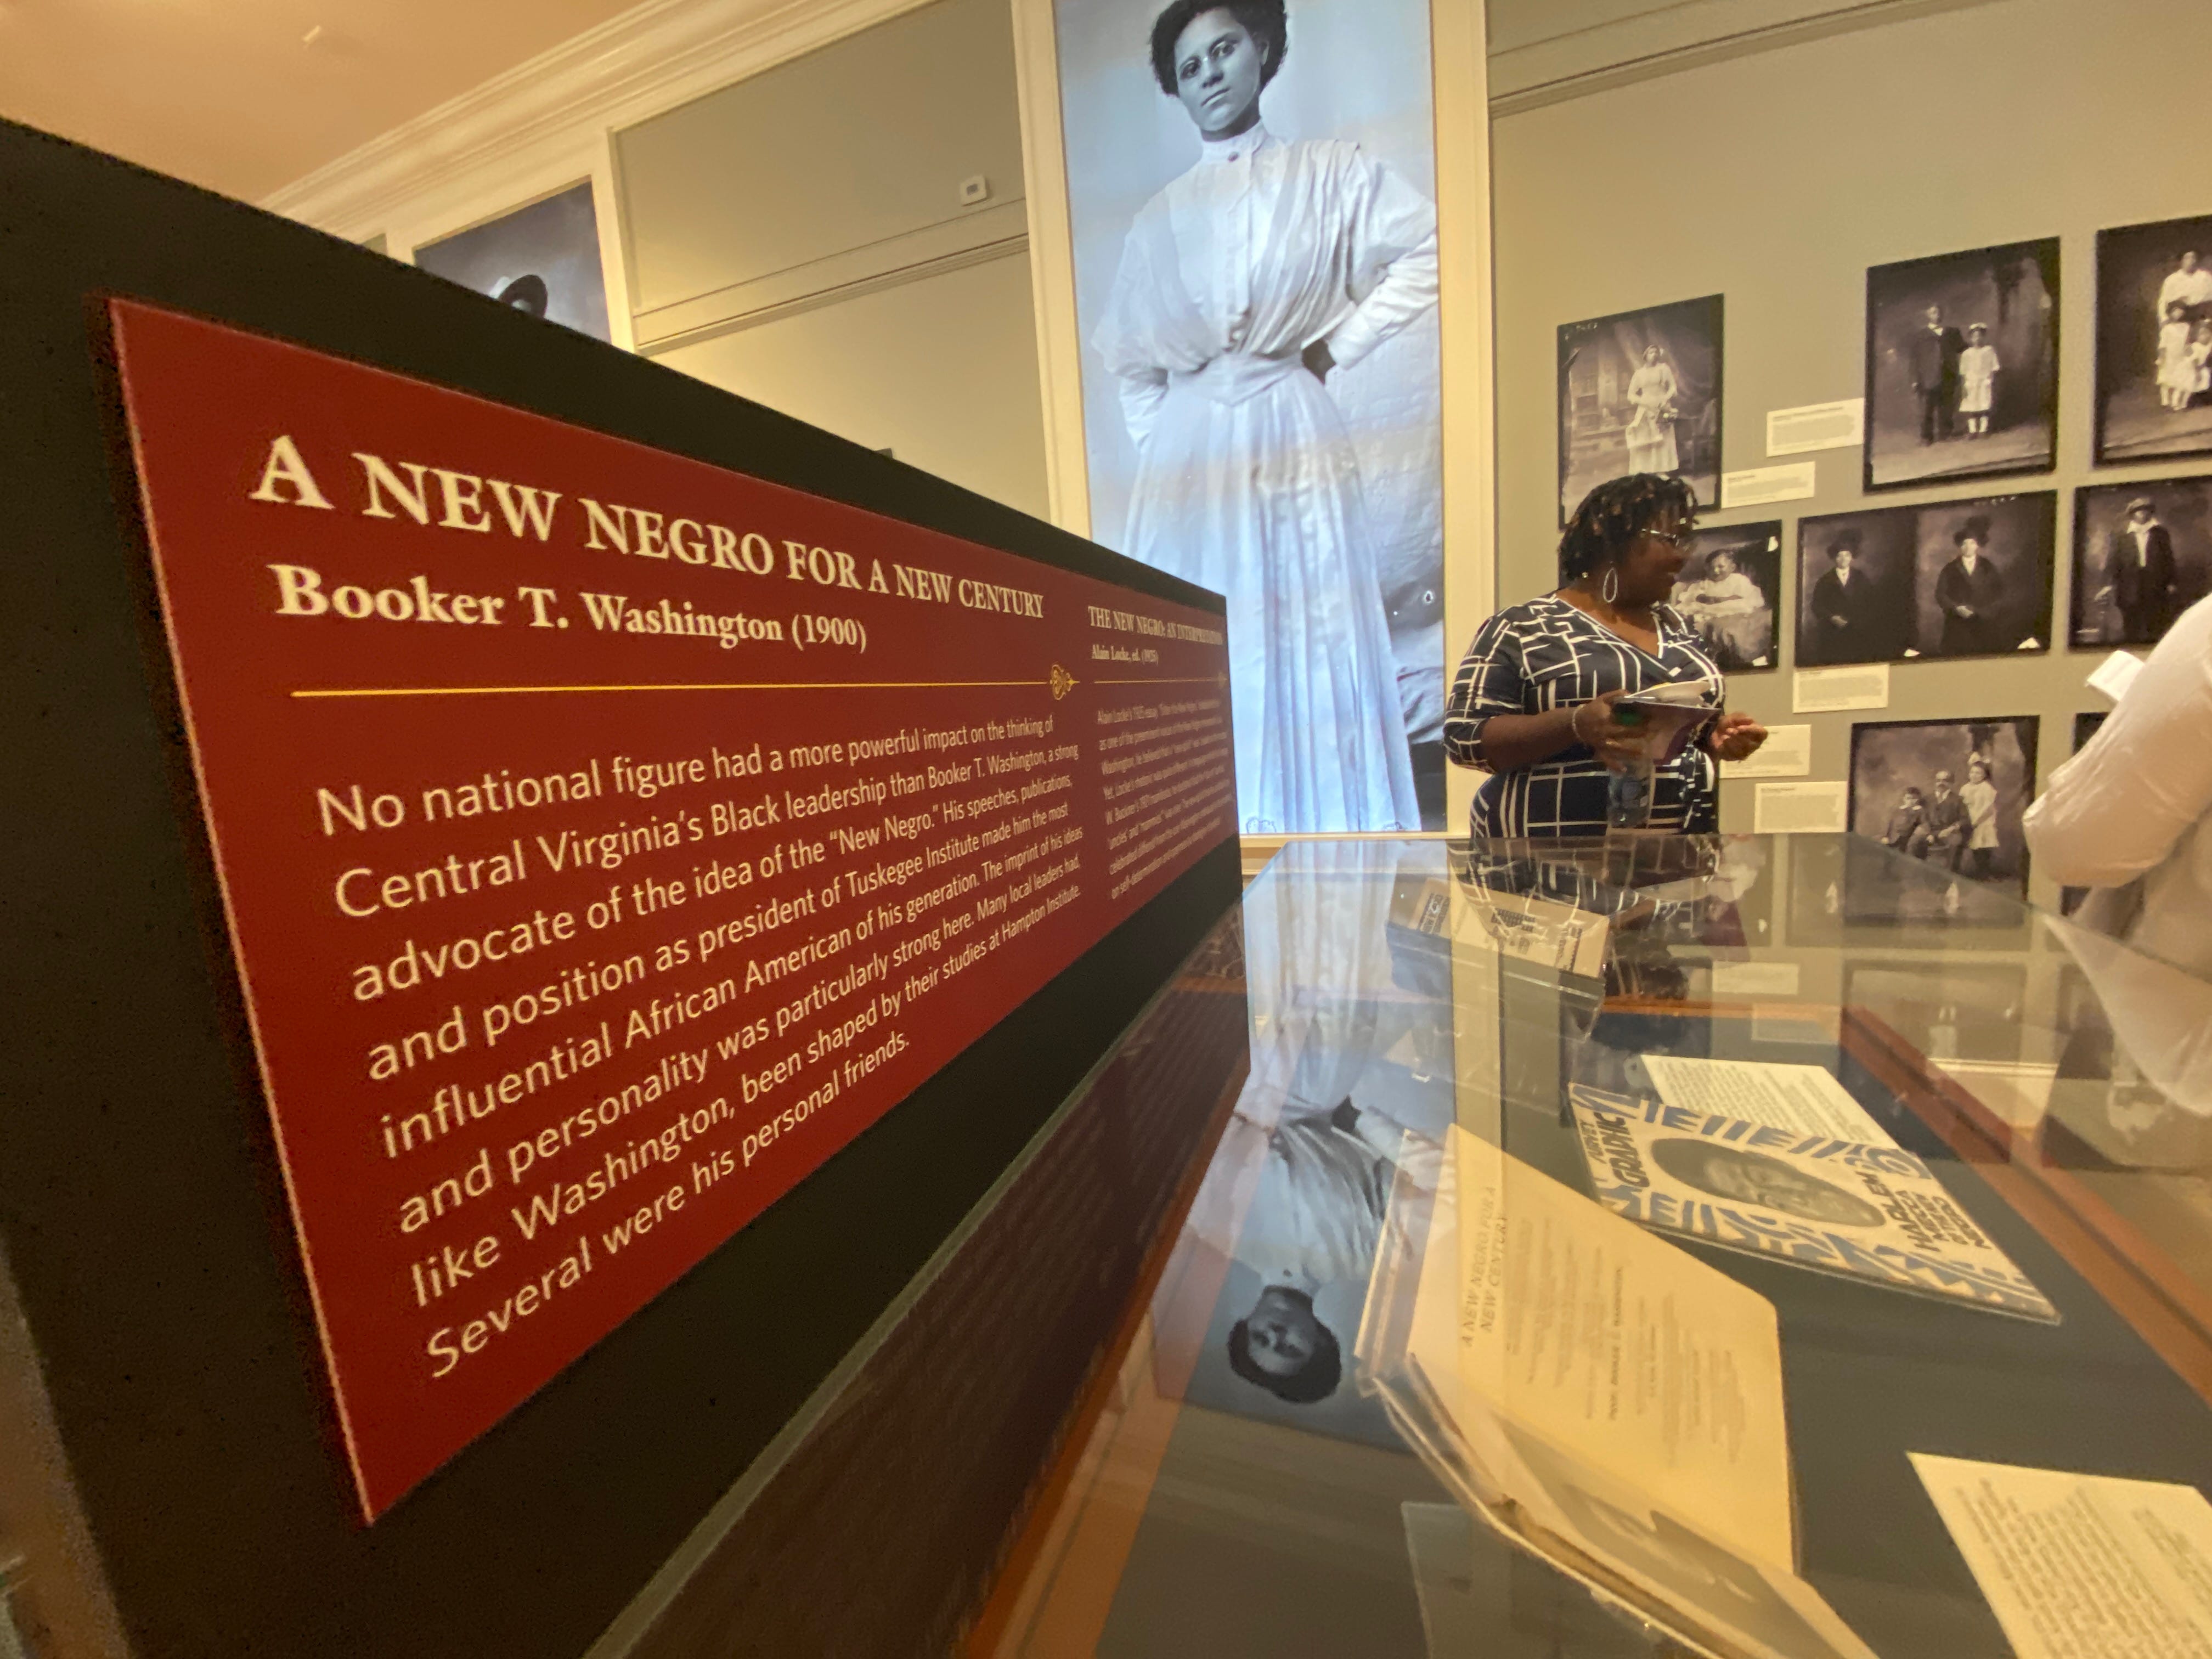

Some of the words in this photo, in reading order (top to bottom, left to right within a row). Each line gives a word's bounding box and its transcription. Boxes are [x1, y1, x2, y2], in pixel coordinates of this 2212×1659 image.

[249, 435, 335, 510] A
[351, 453, 562, 541] NEW
[578, 498, 774, 574] NEGRO
[782, 540, 862, 590] FOR
[868, 559, 889, 594] A
[893, 565, 953, 603] NEW
[958, 579, 1043, 618] CENTURY
[266, 564, 505, 624] Booker
[518, 586, 569, 628] T.
[579, 592, 784, 649] Washington
[792, 614, 866, 653] (1900)
[1088, 606, 1111, 629] THE
[1113, 611, 1135, 631] NEW
[1167, 622, 1177, 638] AN
[317, 785, 405, 836] No
[423, 759, 601, 821] national
[612, 756, 706, 798] figure
[712, 743, 762, 778] had
[770, 751, 783, 771] a
[789, 744, 843, 768] more
[848, 729, 919, 766] powerful
[923, 726, 968, 752] impact
[971, 728, 985, 743] on
[987, 721, 1005, 740] the
[1007, 718, 1044, 738] thinking
[1045, 715, 1053, 732] of
[335, 839, 526, 917] Central
[711, 794, 780, 836] Black
[785, 777, 886, 819] leadership
[890, 772, 924, 797] than
[928, 762, 971, 788] Booker
[974, 758, 984, 777] T.
[987, 751, 1046, 775] Washington,
[1048, 750, 1053, 762] a
[353, 910, 575, 1001] advocate
[587, 885, 622, 929] of
[631, 878, 686, 915] the
[693, 860, 753, 898] idea
[760, 844, 782, 878] of
[789, 839, 825, 869] the
[943, 800, 964, 823] His
[967, 788, 1019, 819] speeches,
[369, 1005, 467, 1080] and
[483, 956, 645, 1046] position
[656, 939, 690, 971] as
[698, 889, 816, 962] president
[821, 876, 840, 907] of
[845, 856, 923, 897] Tuskegee
[926, 834, 979, 867] Institute
[982, 821, 1011, 847] made
[1013, 816, 1031, 835] him
[1032, 810, 1047, 828] the
[1048, 803, 1068, 821] most
[381, 1022, 612, 1158] influential
[625, 979, 736, 1049] African
[744, 929, 851, 993] American
[856, 910, 873, 940] of
[878, 903, 902, 930] his
[906, 874, 979, 922] generation.
[981, 861, 1003, 881] The
[1005, 843, 1039, 872] imprint
[1041, 837, 1048, 855] of
[1051, 833, 1063, 850] his
[1064, 827, 1084, 844] ideas
[400, 1148, 493, 1233] and
[508, 1049, 708, 1184] personality
[716, 1018, 769, 1060] was
[776, 953, 888, 1037] particularly
[943, 913, 974, 939] here.
[977, 894, 1007, 921] Many
[1009, 877, 1032, 903] local
[1034, 865, 1064, 890] leaders
[411, 1236, 500, 1306] like
[511, 1098, 735, 1239] Washington,
[741, 1053, 801, 1103] been
[807, 999, 877, 1063] shaped
[881, 991, 901, 1017] by
[905, 967, 939, 1002] their
[943, 941, 986, 979] studies
[989, 929, 1000, 950] at
[1002, 906, 1045, 942] Hampton
[1593, 1111, 1650, 1187] GRAPHIC
[427, 1236, 592, 1378] Several
[602, 1186, 685, 1254] were
[692, 1150, 735, 1194] his
[742, 1070, 839, 1167] personal
[844, 1031, 909, 1087] friends.
[1855, 1171, 1941, 1252] HARLEM
